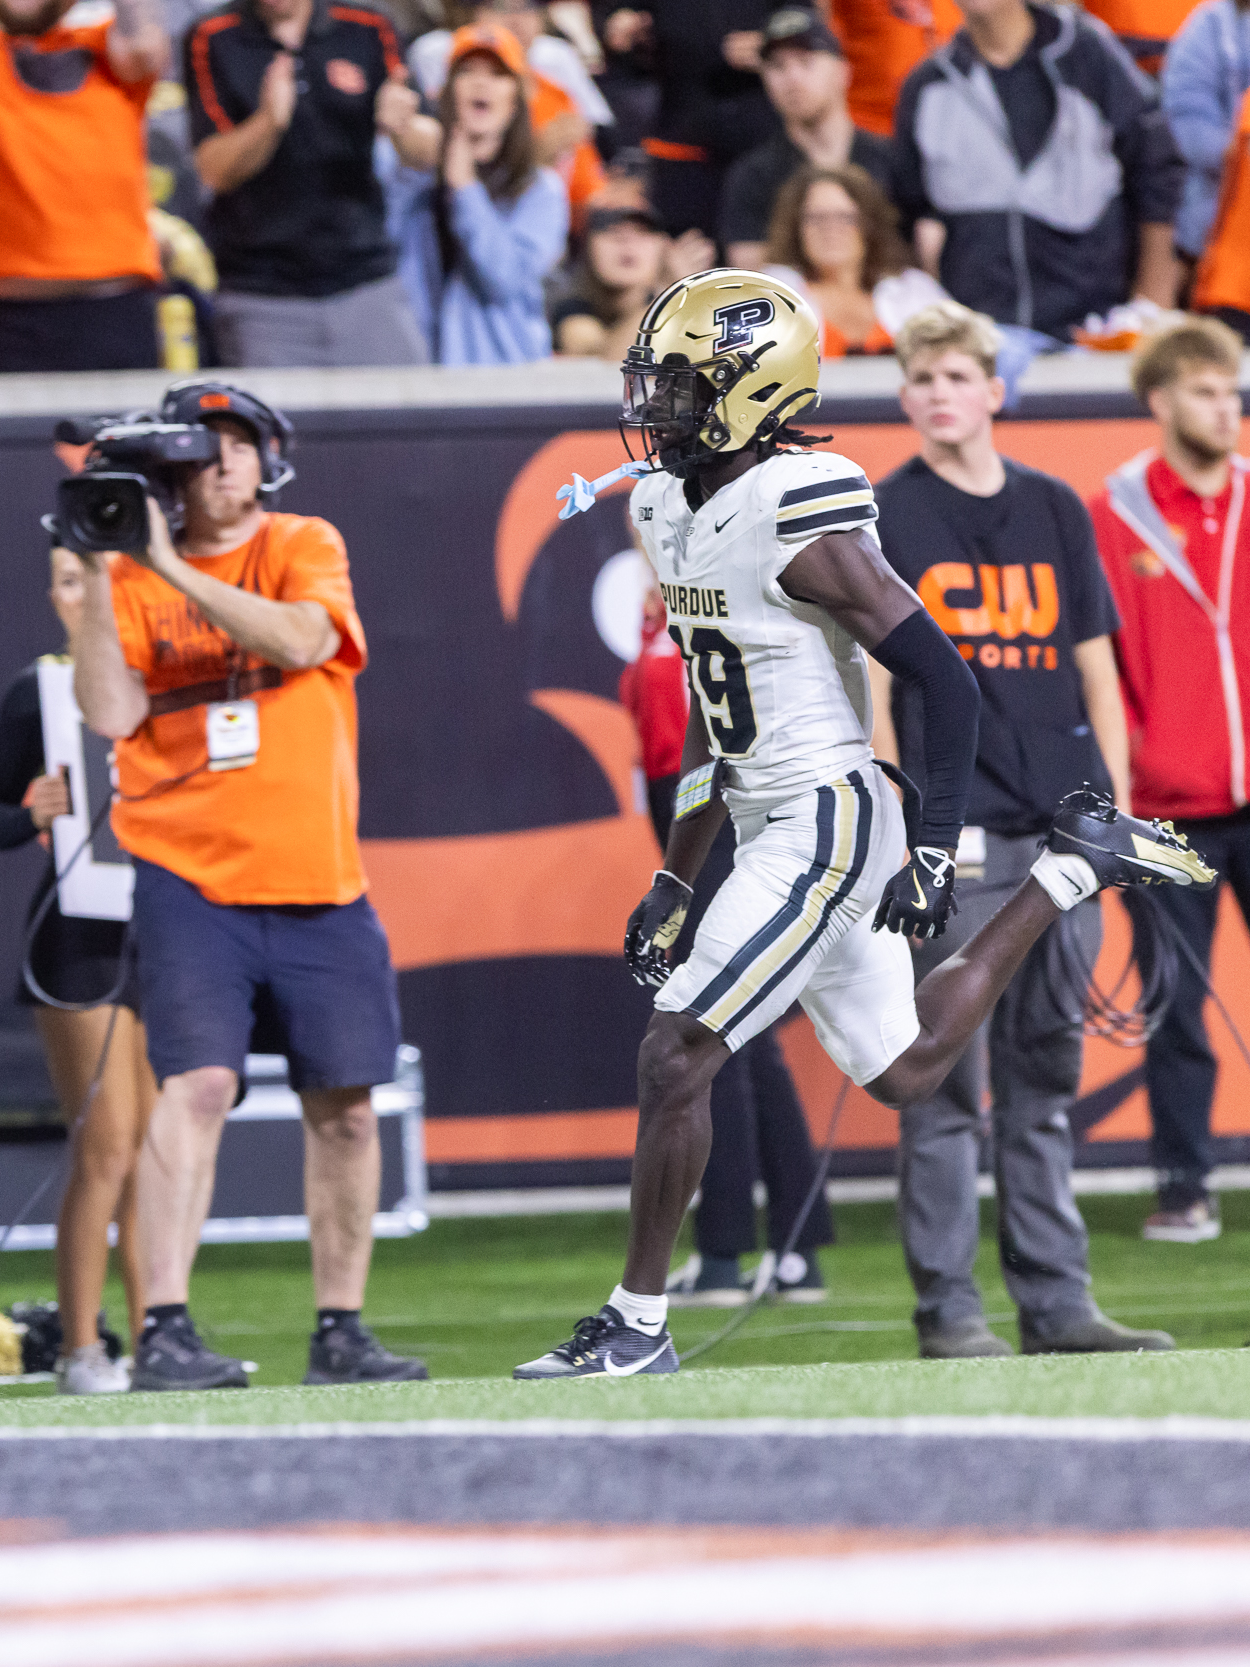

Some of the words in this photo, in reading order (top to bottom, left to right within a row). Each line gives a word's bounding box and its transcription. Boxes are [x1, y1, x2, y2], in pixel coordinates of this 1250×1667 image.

[712, 297, 775, 357] P
[660, 582, 731, 619] PURDUE
[916, 561, 1060, 641] CW
[957, 643, 1058, 671] PORTS
[667, 621, 760, 760] 19
